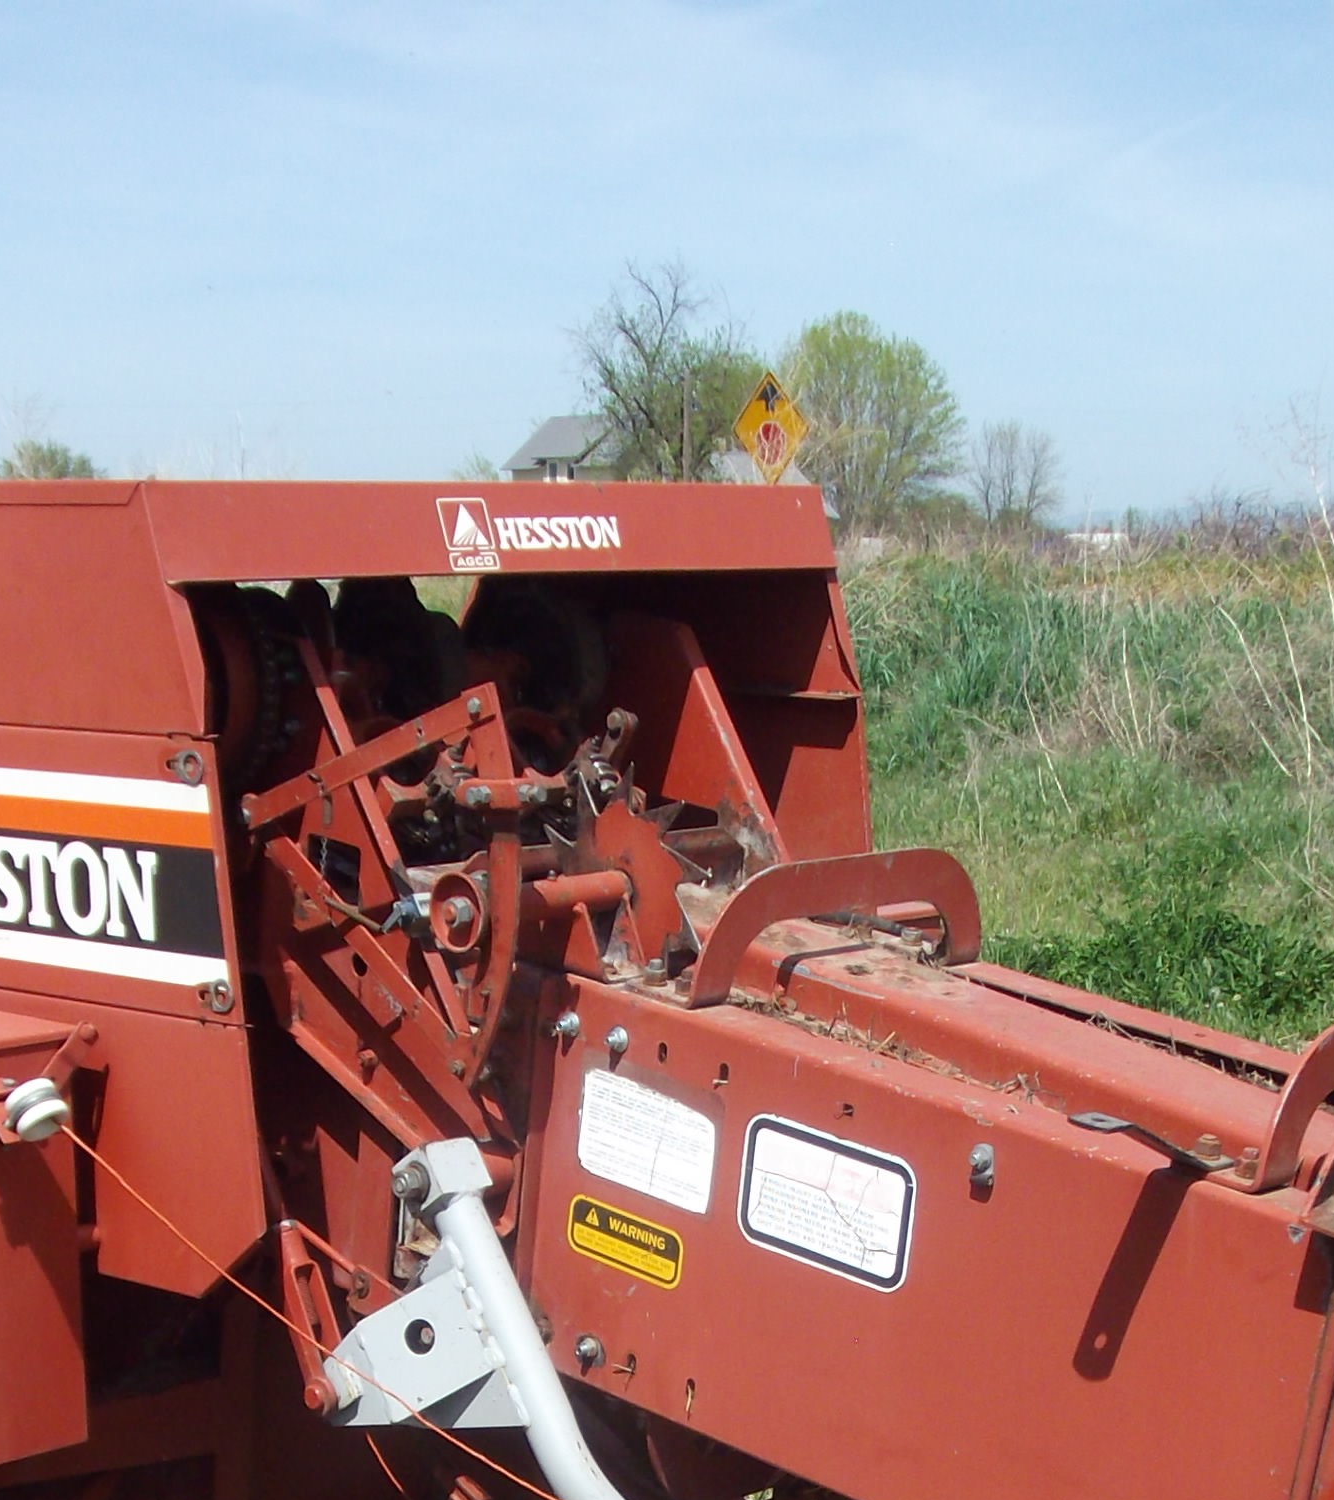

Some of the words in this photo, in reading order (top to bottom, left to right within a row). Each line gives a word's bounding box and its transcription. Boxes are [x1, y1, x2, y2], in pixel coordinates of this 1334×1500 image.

[494, 516, 621, 549] HESSTON
[457, 555, 495, 568] AGCO
[609, 1216, 666, 1250] WARNING
